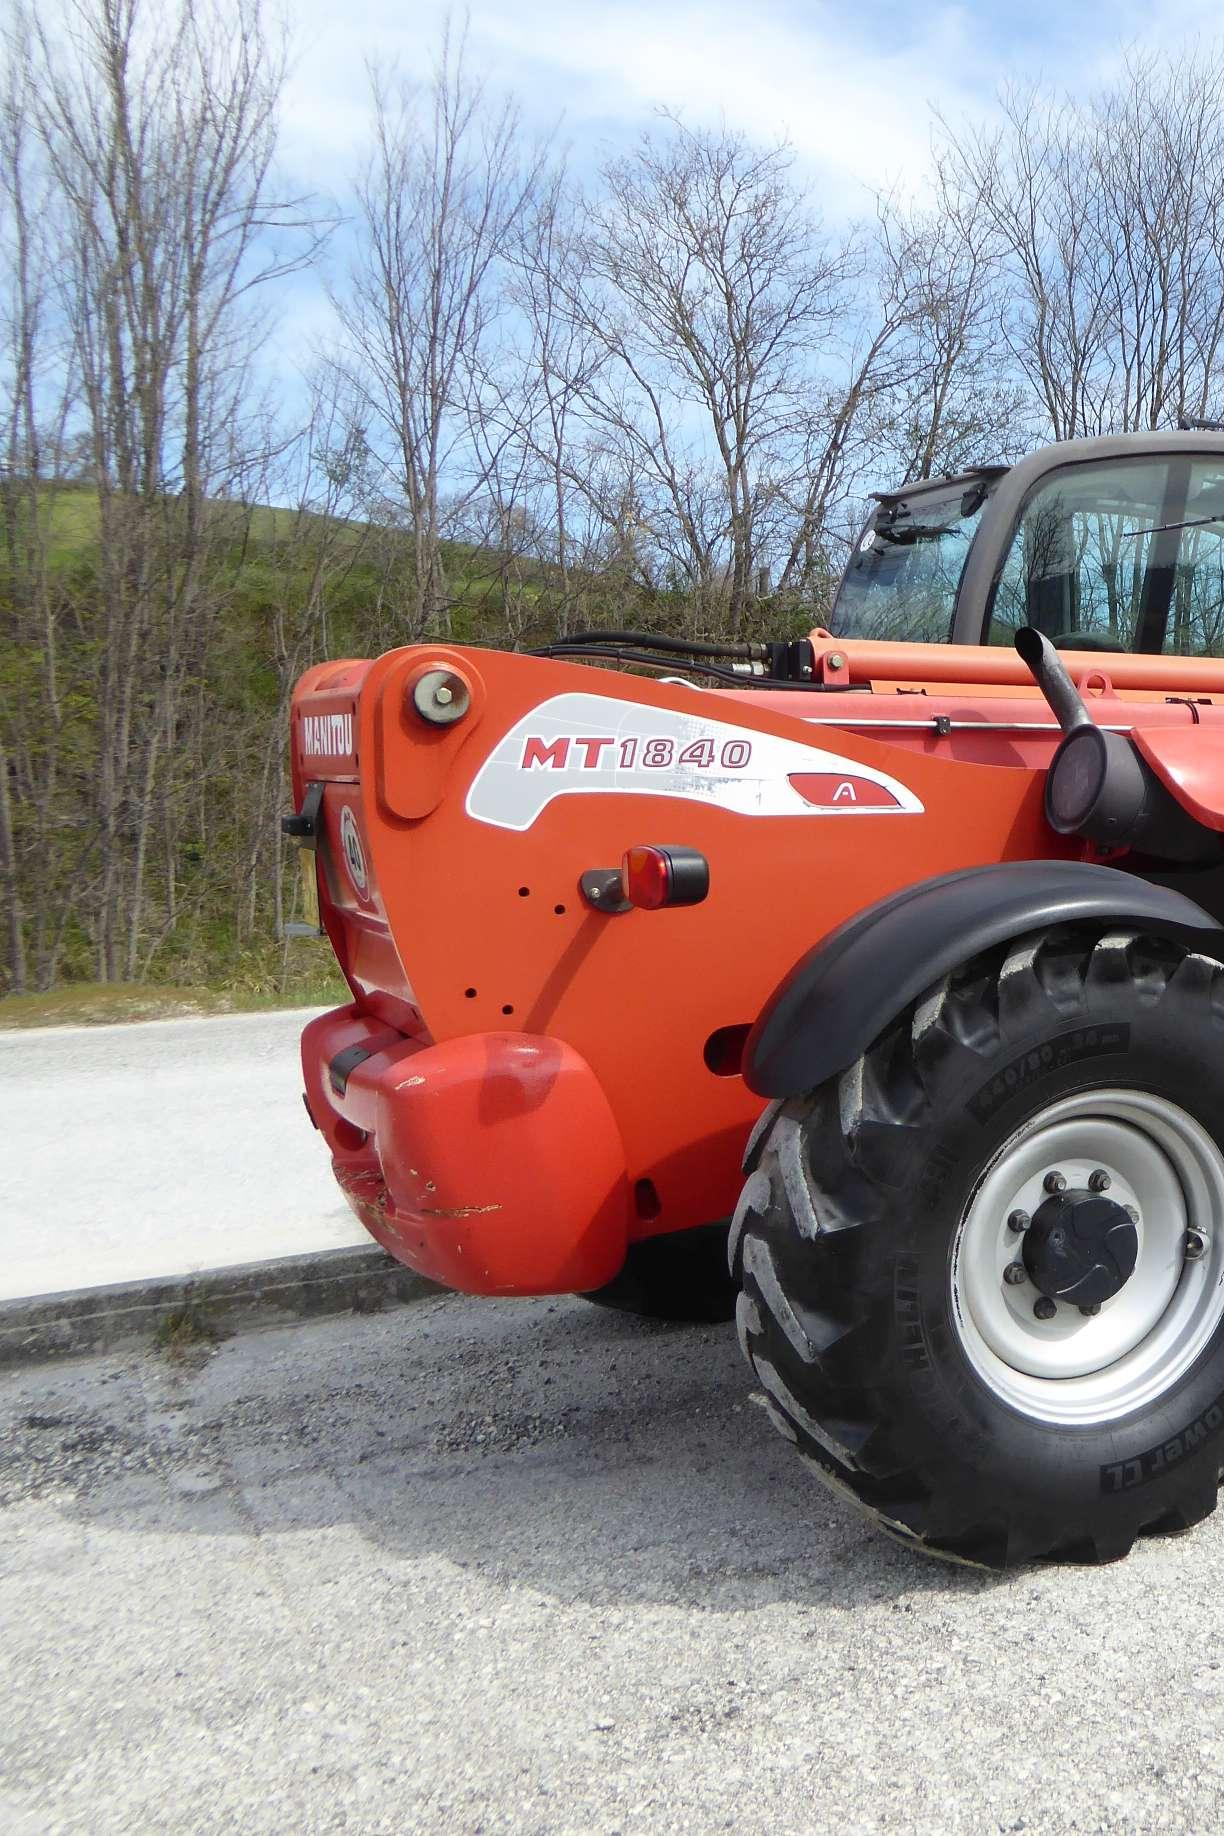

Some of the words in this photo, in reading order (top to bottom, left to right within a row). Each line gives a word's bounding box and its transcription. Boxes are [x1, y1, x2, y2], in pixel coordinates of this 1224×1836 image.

[304, 713, 353, 755] MANITOU
[521, 737, 752, 769] MT1840
[833, 782, 856, 801] A
[347, 833, 362, 873] 40
